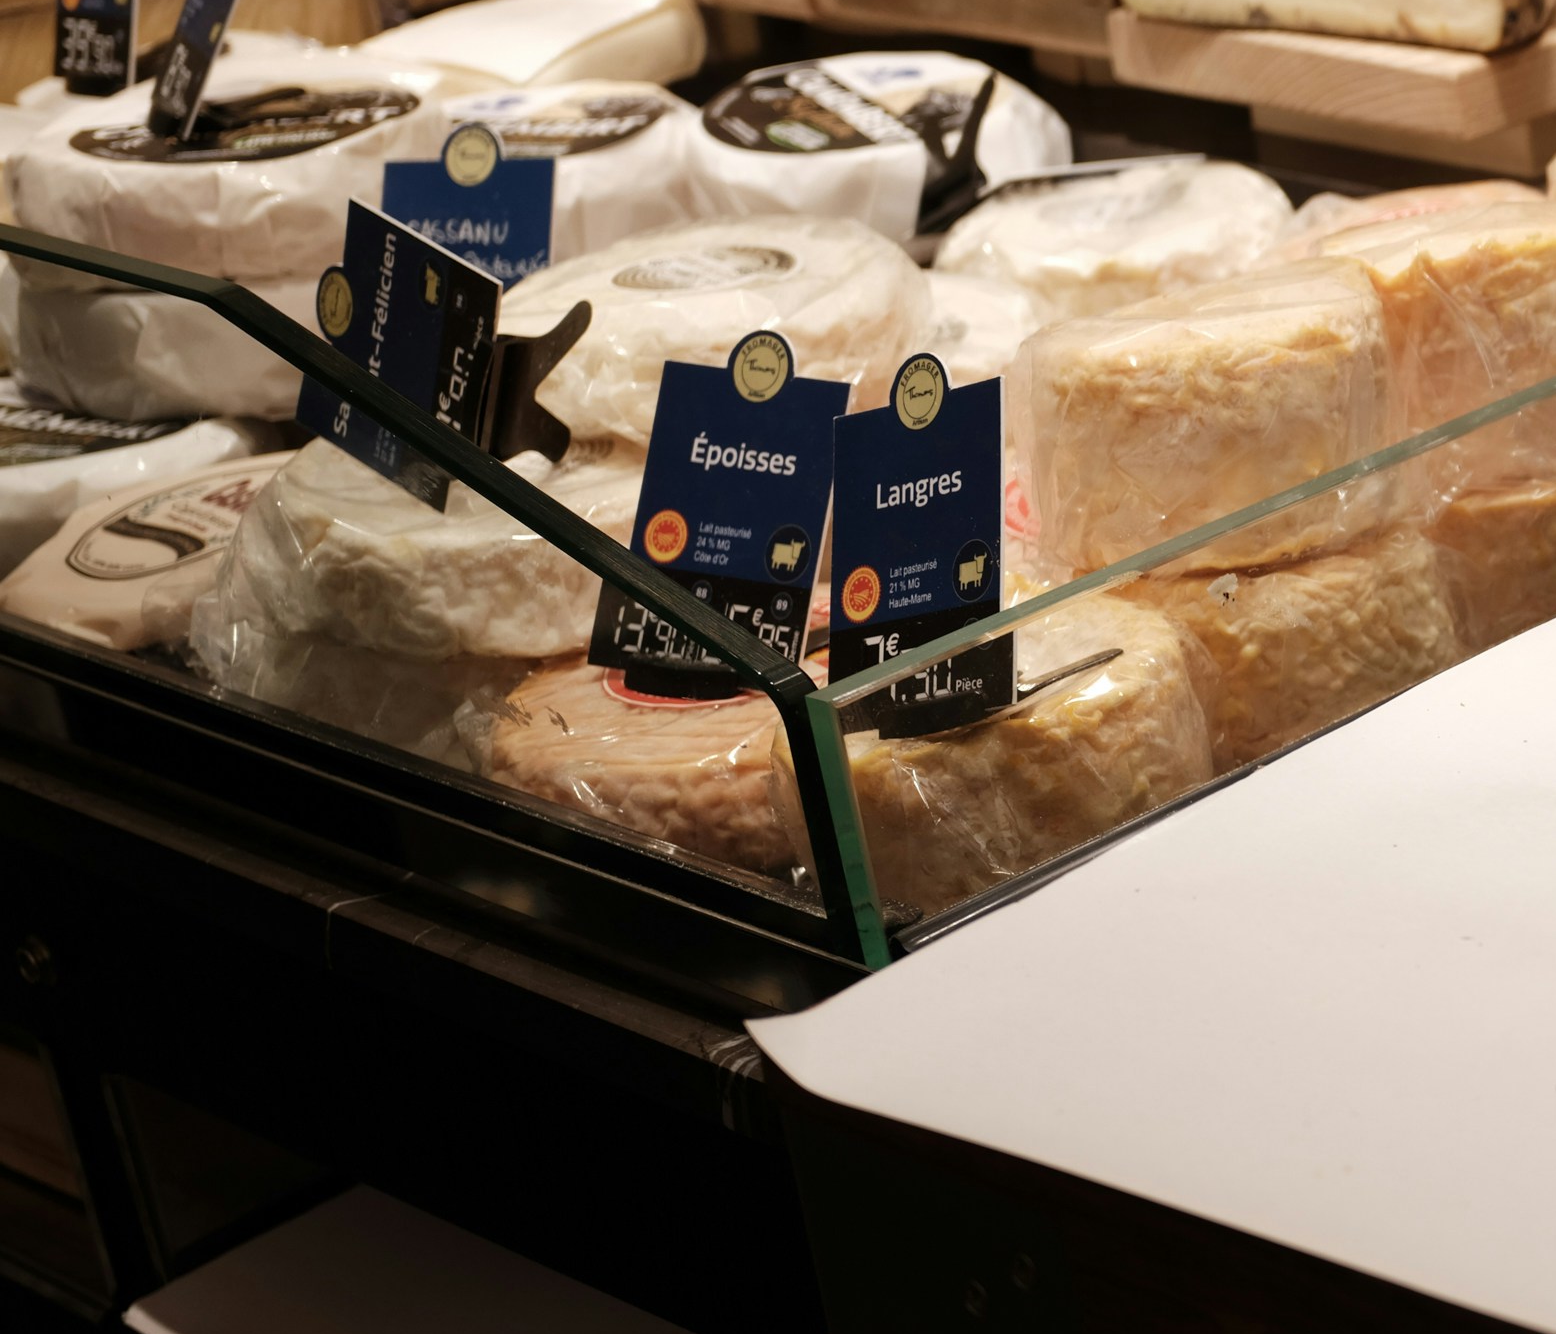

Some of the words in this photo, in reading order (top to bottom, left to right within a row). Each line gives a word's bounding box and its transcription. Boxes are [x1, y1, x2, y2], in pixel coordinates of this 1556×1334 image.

[742, 337, 786, 361] FROMAGER
[900, 361, 940, 387] FROMAGER
[690, 431, 797, 476] Époisses
[876, 469, 962, 509] Langres
[699, 522, 714, 535] Lait
[713, 524, 752, 540] pasteurisé
[716, 539, 731, 551] MG
[694, 550, 712, 563] Côte
[712, 552, 729, 566] d'Or
[889, 567, 903, 578] Lait
[903, 559, 938, 577] pasteurisé
[889, 582, 900, 594] 21
[907, 577, 920, 589] MG
[888, 592, 932, 609] Haute-Marne
[955, 676, 984, 692] Pièce
